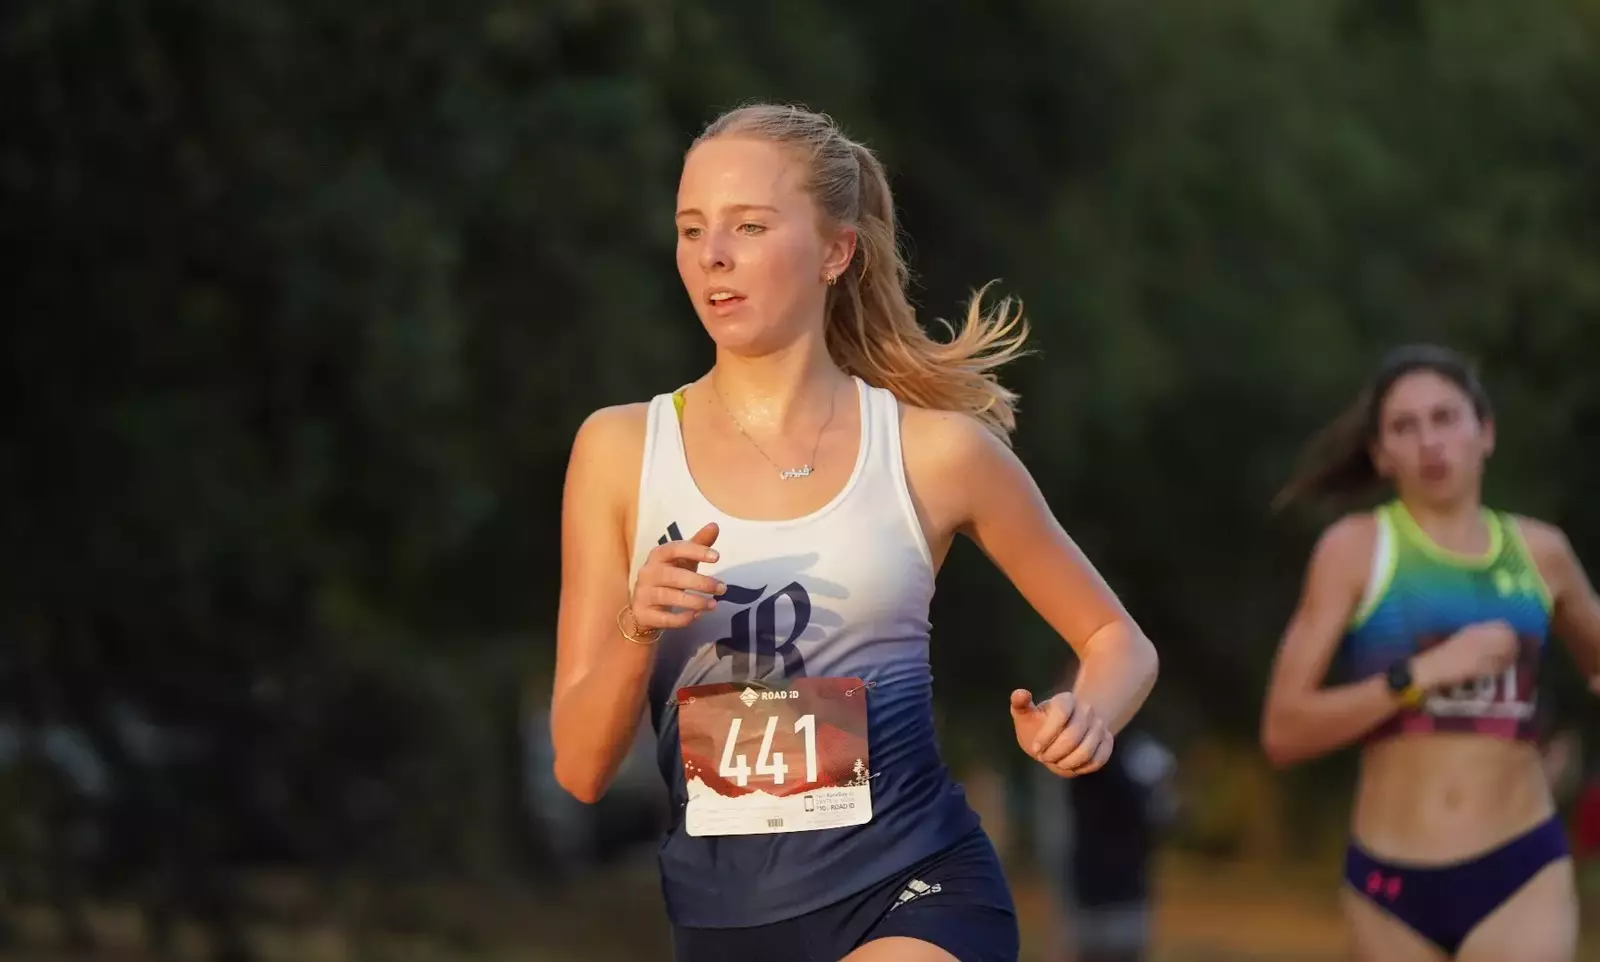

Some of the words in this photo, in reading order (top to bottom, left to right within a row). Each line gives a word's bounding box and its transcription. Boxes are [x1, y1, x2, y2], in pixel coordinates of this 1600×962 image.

[761, 690, 787, 700] ROAD
[719, 714, 818, 787] 441
[830, 803, 848, 811] ROAD
